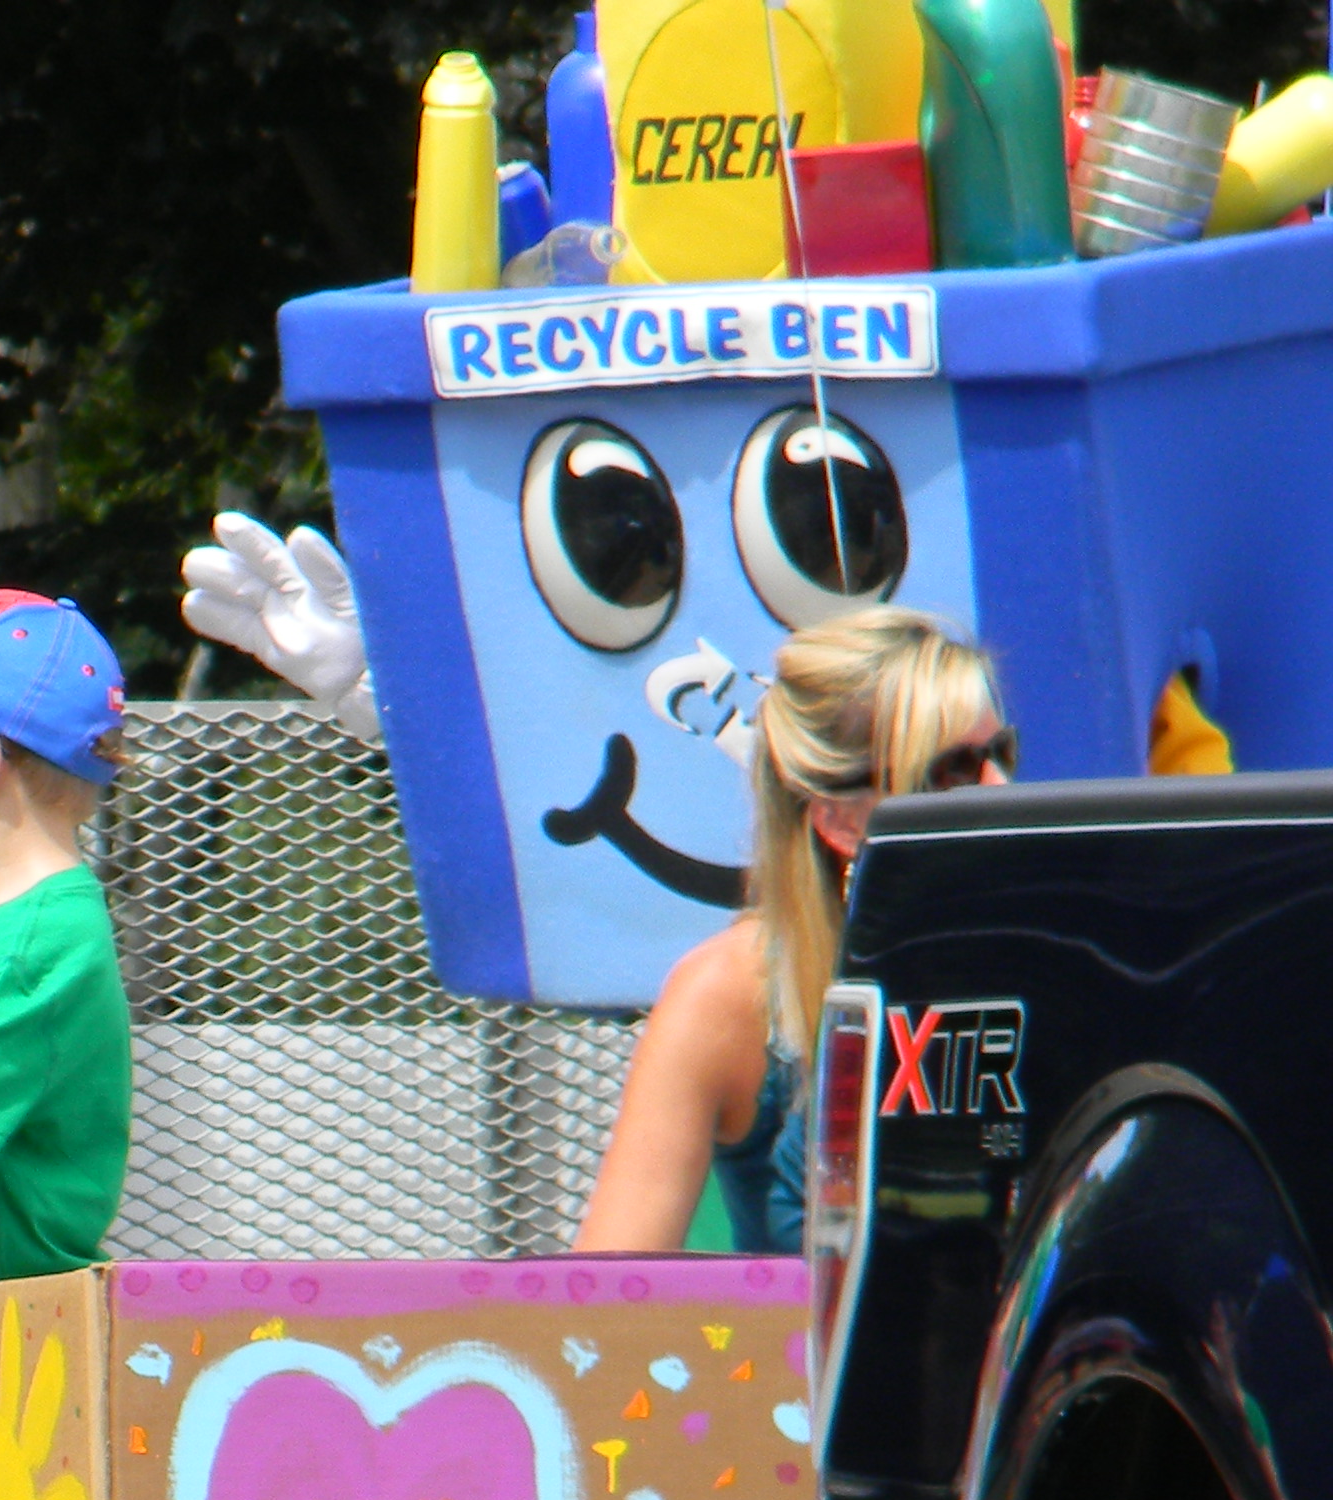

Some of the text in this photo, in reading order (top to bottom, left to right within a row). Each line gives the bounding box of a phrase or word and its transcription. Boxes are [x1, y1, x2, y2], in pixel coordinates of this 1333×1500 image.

[447, 301, 913, 383] RECYCLE BEN
[878, 996, 1026, 1117] XTR
